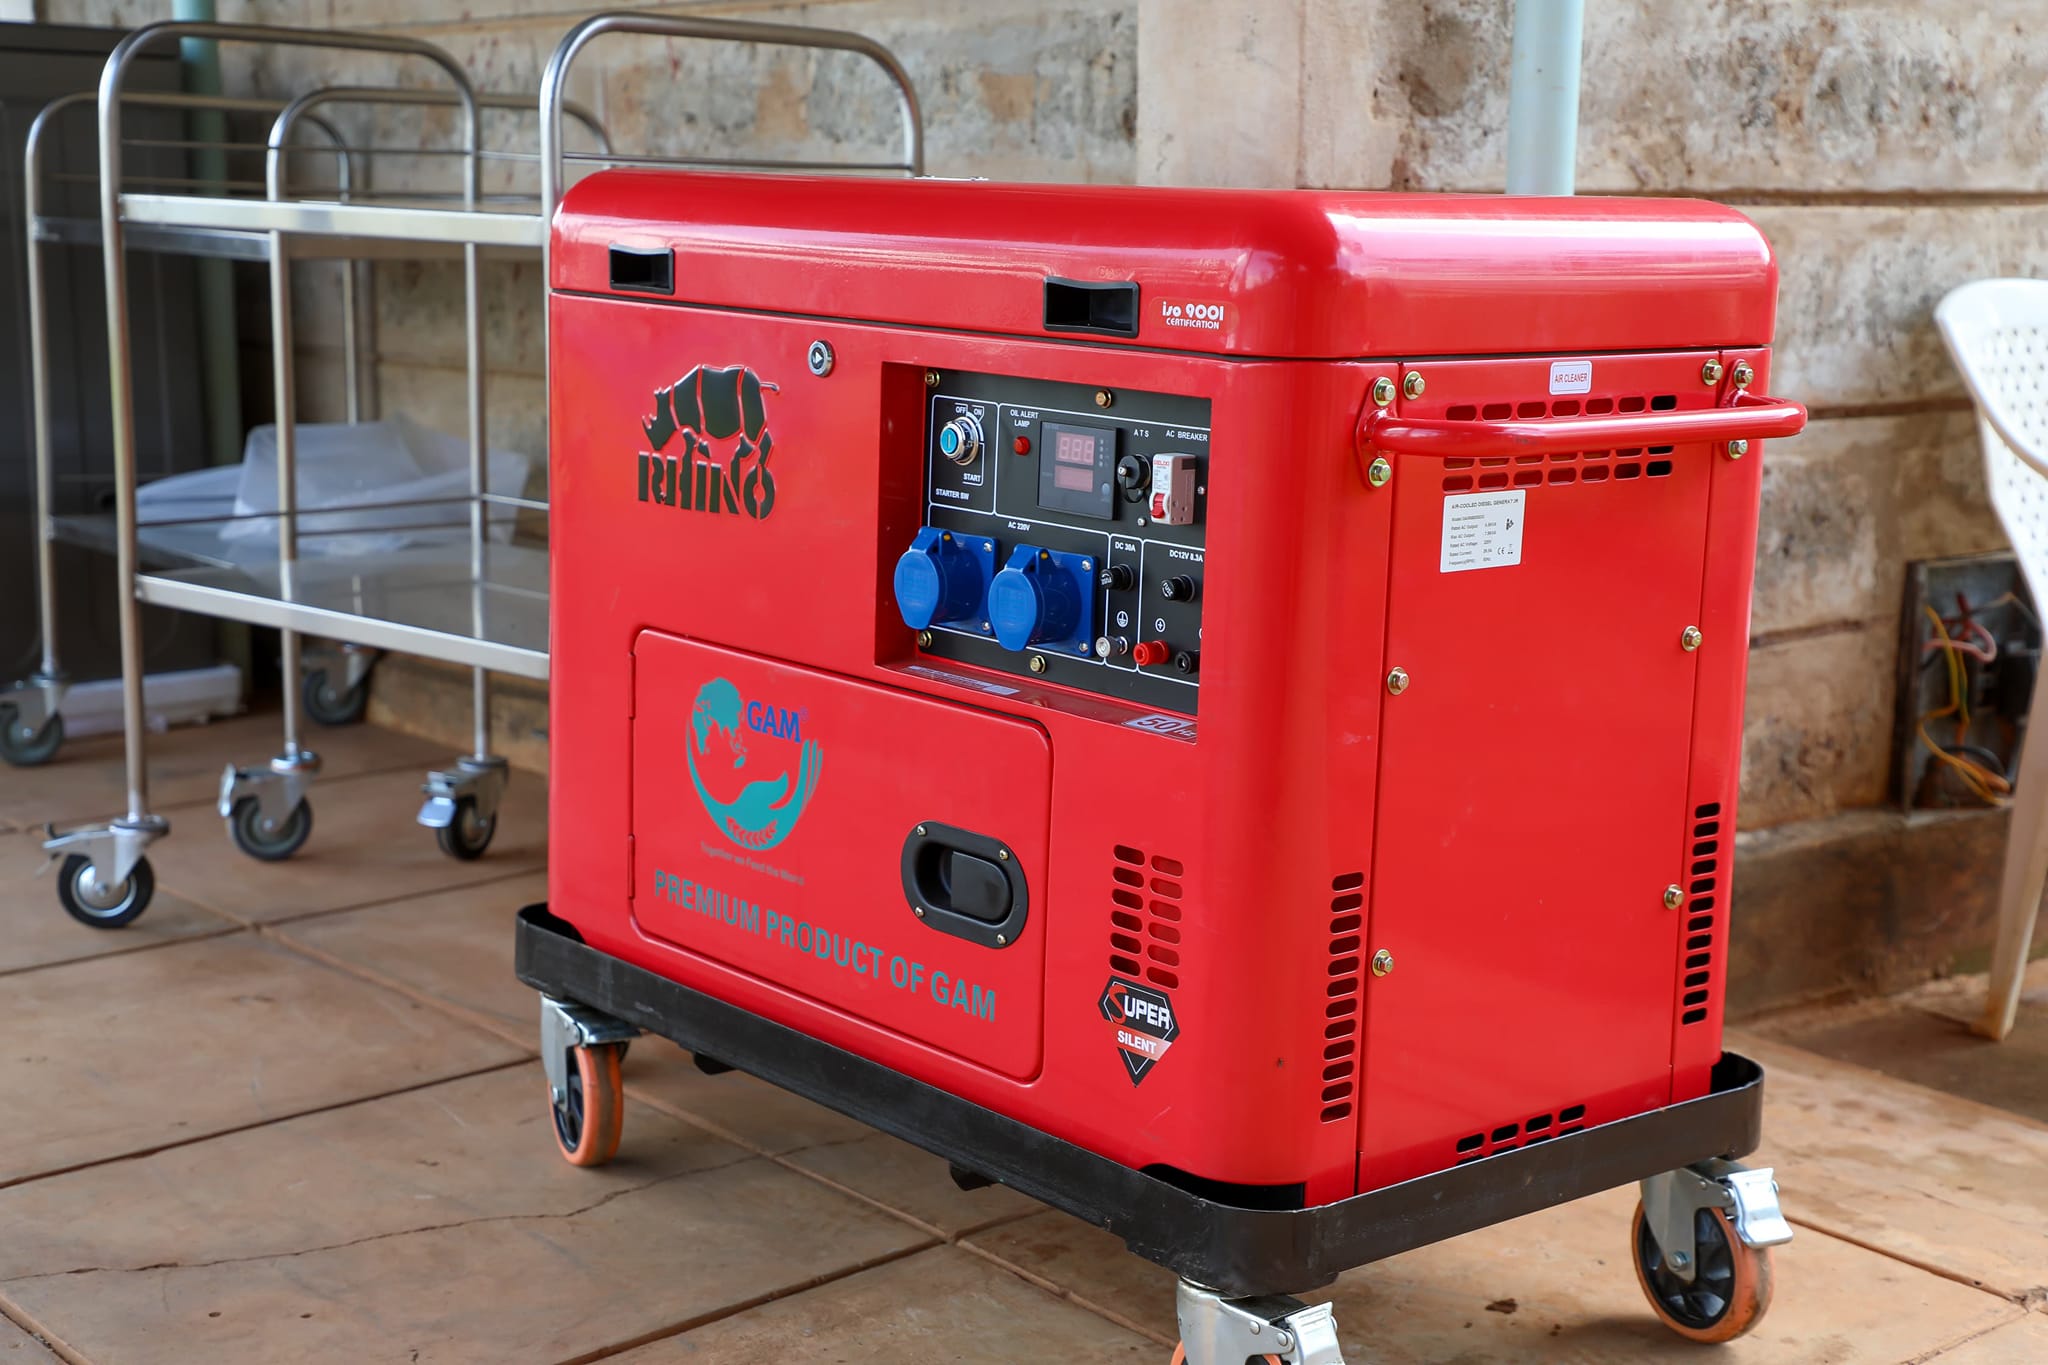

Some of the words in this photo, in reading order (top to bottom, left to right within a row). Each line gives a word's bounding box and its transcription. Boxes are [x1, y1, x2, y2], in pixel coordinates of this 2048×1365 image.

[1185, 303, 1224, 321] 9001
[1166, 317, 1219, 330] CERTIFICATION
[1555, 373, 1563, 383] AIR
[1564, 372, 1587, 382] CLEANER
[955, 406, 967, 414] OFF
[973, 408, 983, 416] ON
[1009, 409, 1019, 417] OIL
[1020, 410, 1039, 419] ALERT
[1014, 419, 1030, 428] LAMP
[1165, 429, 1175, 438] AC
[1177, 431, 1208, 442] BREAKER
[963, 473, 981, 482] START
[638, 450, 776, 520] RHINO
[936, 488, 960, 499] STARTER
[1007, 521, 1017, 529] AC
[1114, 541, 1124, 550] DC
[1162, 582, 1174, 597] FUSE
[747, 700, 801, 743] GAM
[1137, 717, 1181, 730] 50
[655, 869, 760, 935] PREMIUM
[766, 909, 884, 979] PRODUCT
[890, 955, 924, 993] OF
[930, 971, 996, 1022] GAM
[1108, 984, 1170, 1030] SUPER
[1117, 1030, 1158, 1055] SILENT
